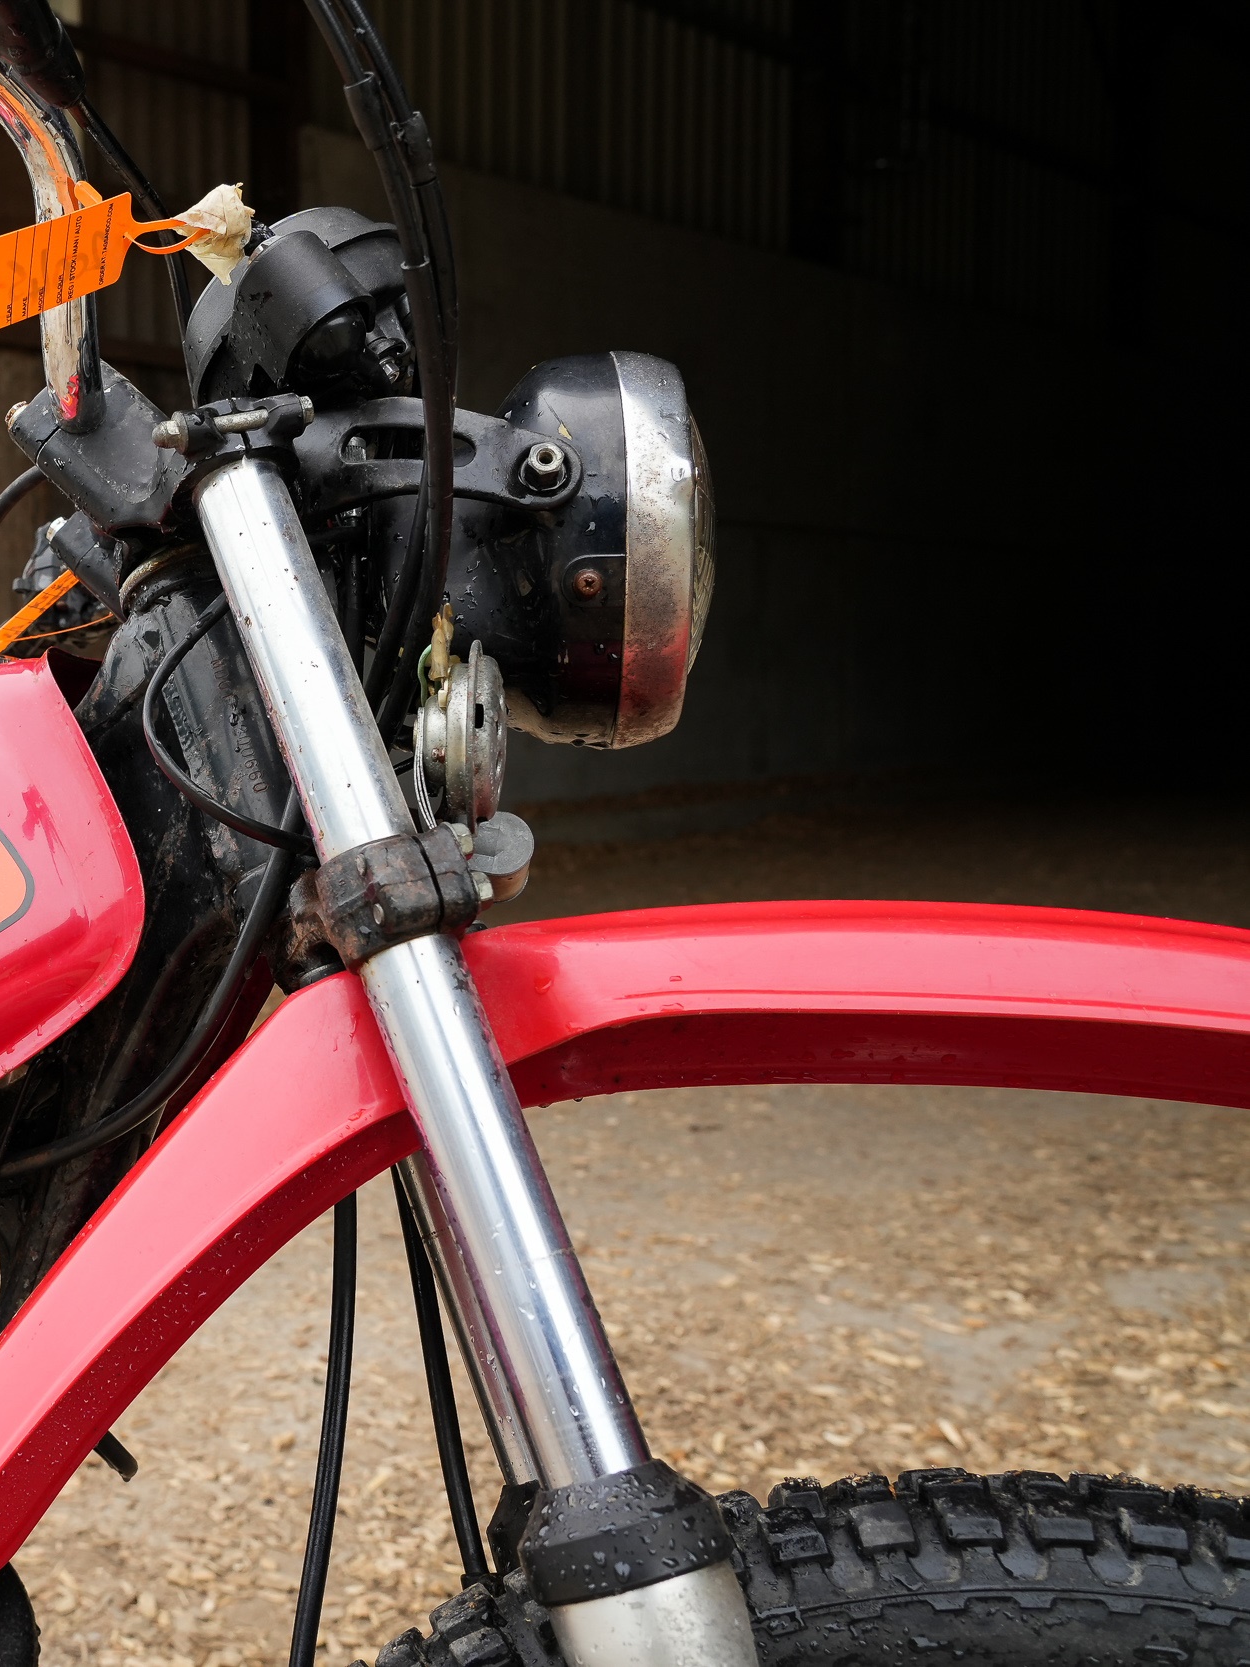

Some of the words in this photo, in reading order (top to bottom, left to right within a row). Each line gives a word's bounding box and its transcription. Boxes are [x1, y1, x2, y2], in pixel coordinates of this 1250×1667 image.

[74, 216, 83, 234] AUTO
[69, 259, 77, 280] STOCK
[56, 274, 65, 304] COLOUR
[67, 284, 75, 299] REG
